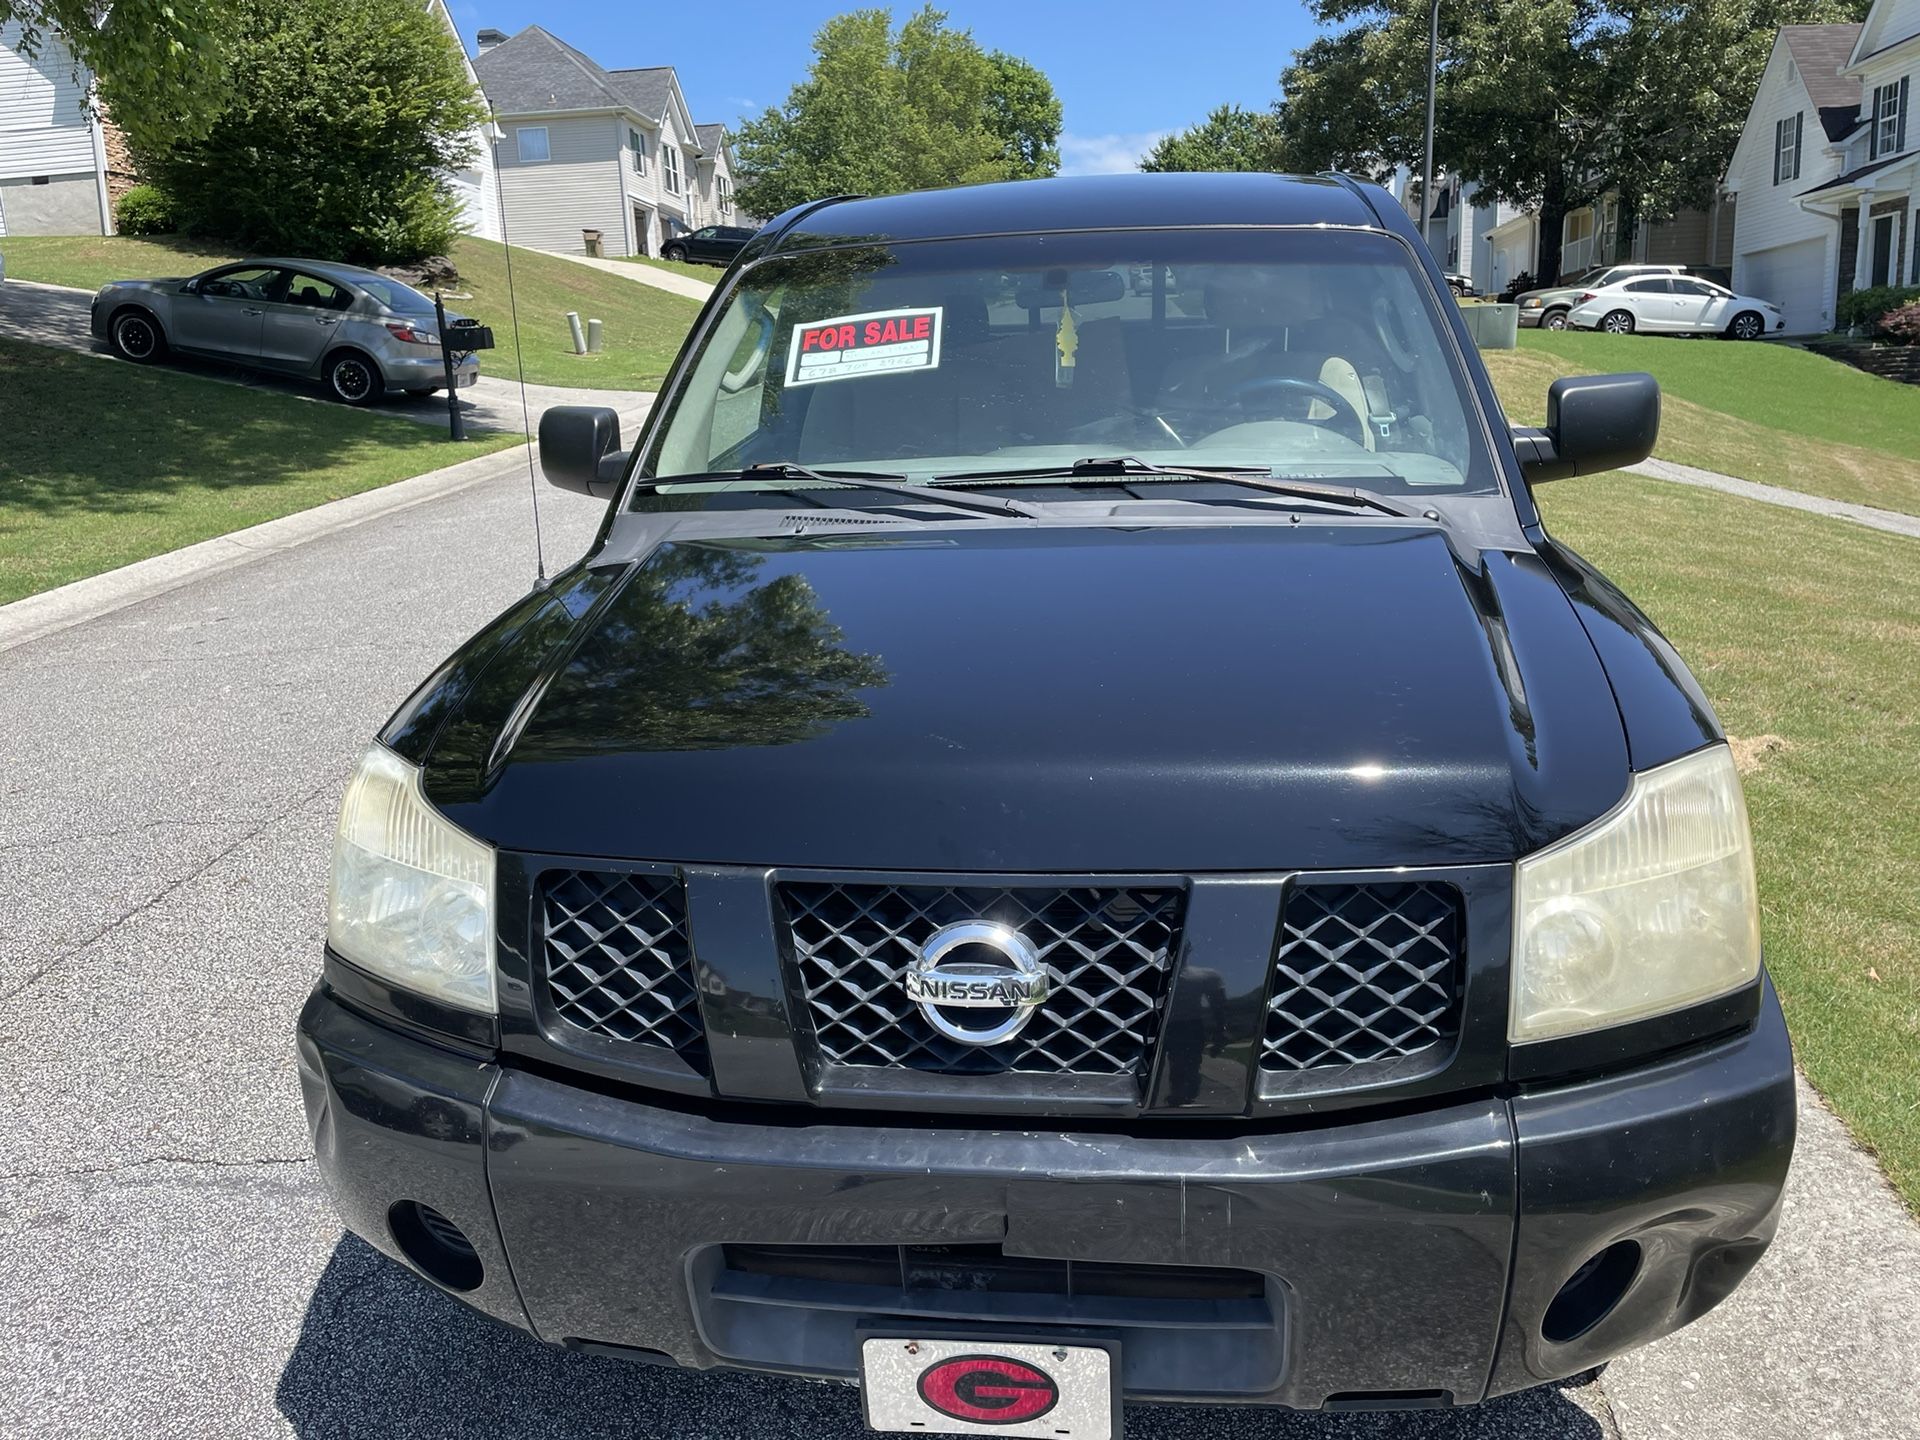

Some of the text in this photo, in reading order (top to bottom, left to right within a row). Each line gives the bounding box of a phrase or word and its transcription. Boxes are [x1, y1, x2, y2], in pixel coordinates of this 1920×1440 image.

[803, 325, 856, 351] FOR
[864, 317, 931, 345] SALE
[920, 980, 1031, 1001] NISSAN
[922, 1359, 1052, 1421] G
